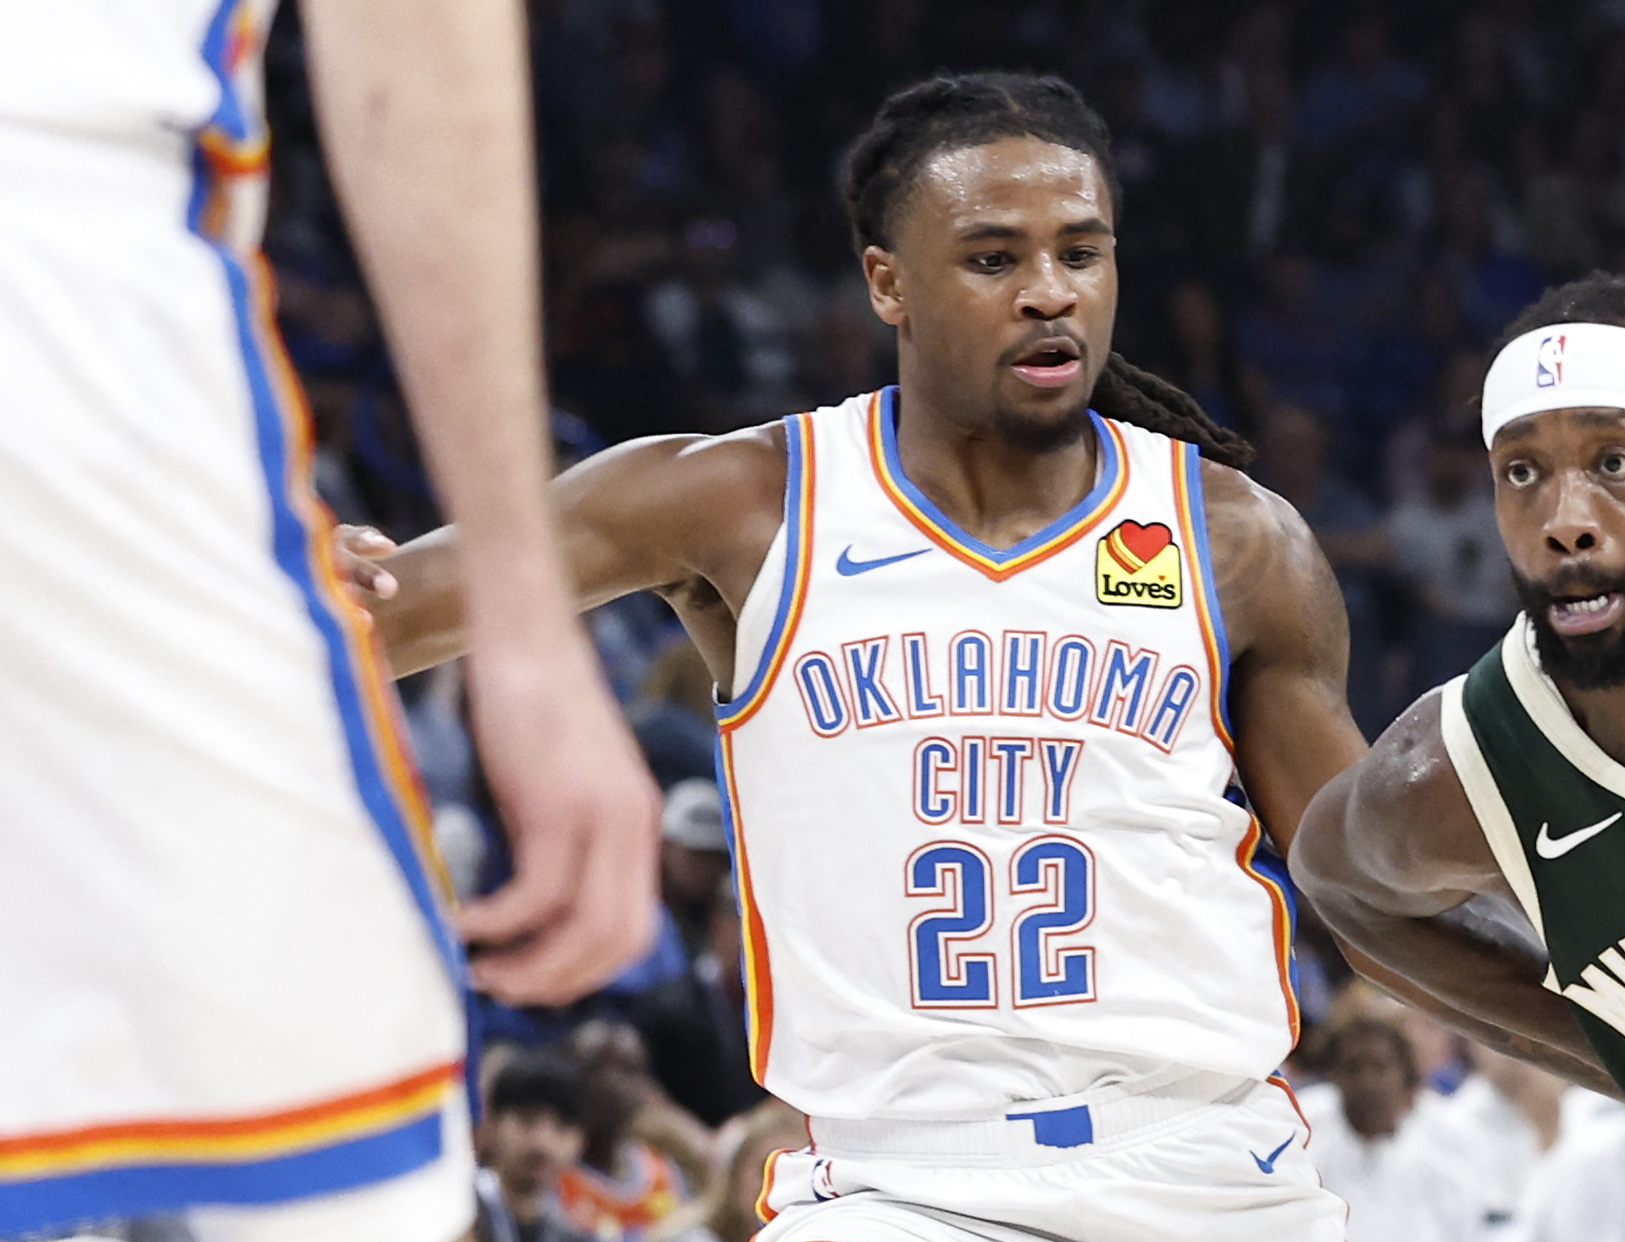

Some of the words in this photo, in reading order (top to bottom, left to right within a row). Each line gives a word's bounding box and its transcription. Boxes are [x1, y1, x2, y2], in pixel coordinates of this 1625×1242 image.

[1103, 573, 1176, 600] Love's
[794, 630, 1201, 754] OKLAHOMA
[912, 736, 1085, 826] CITY
[904, 834, 1097, 1010] 22
